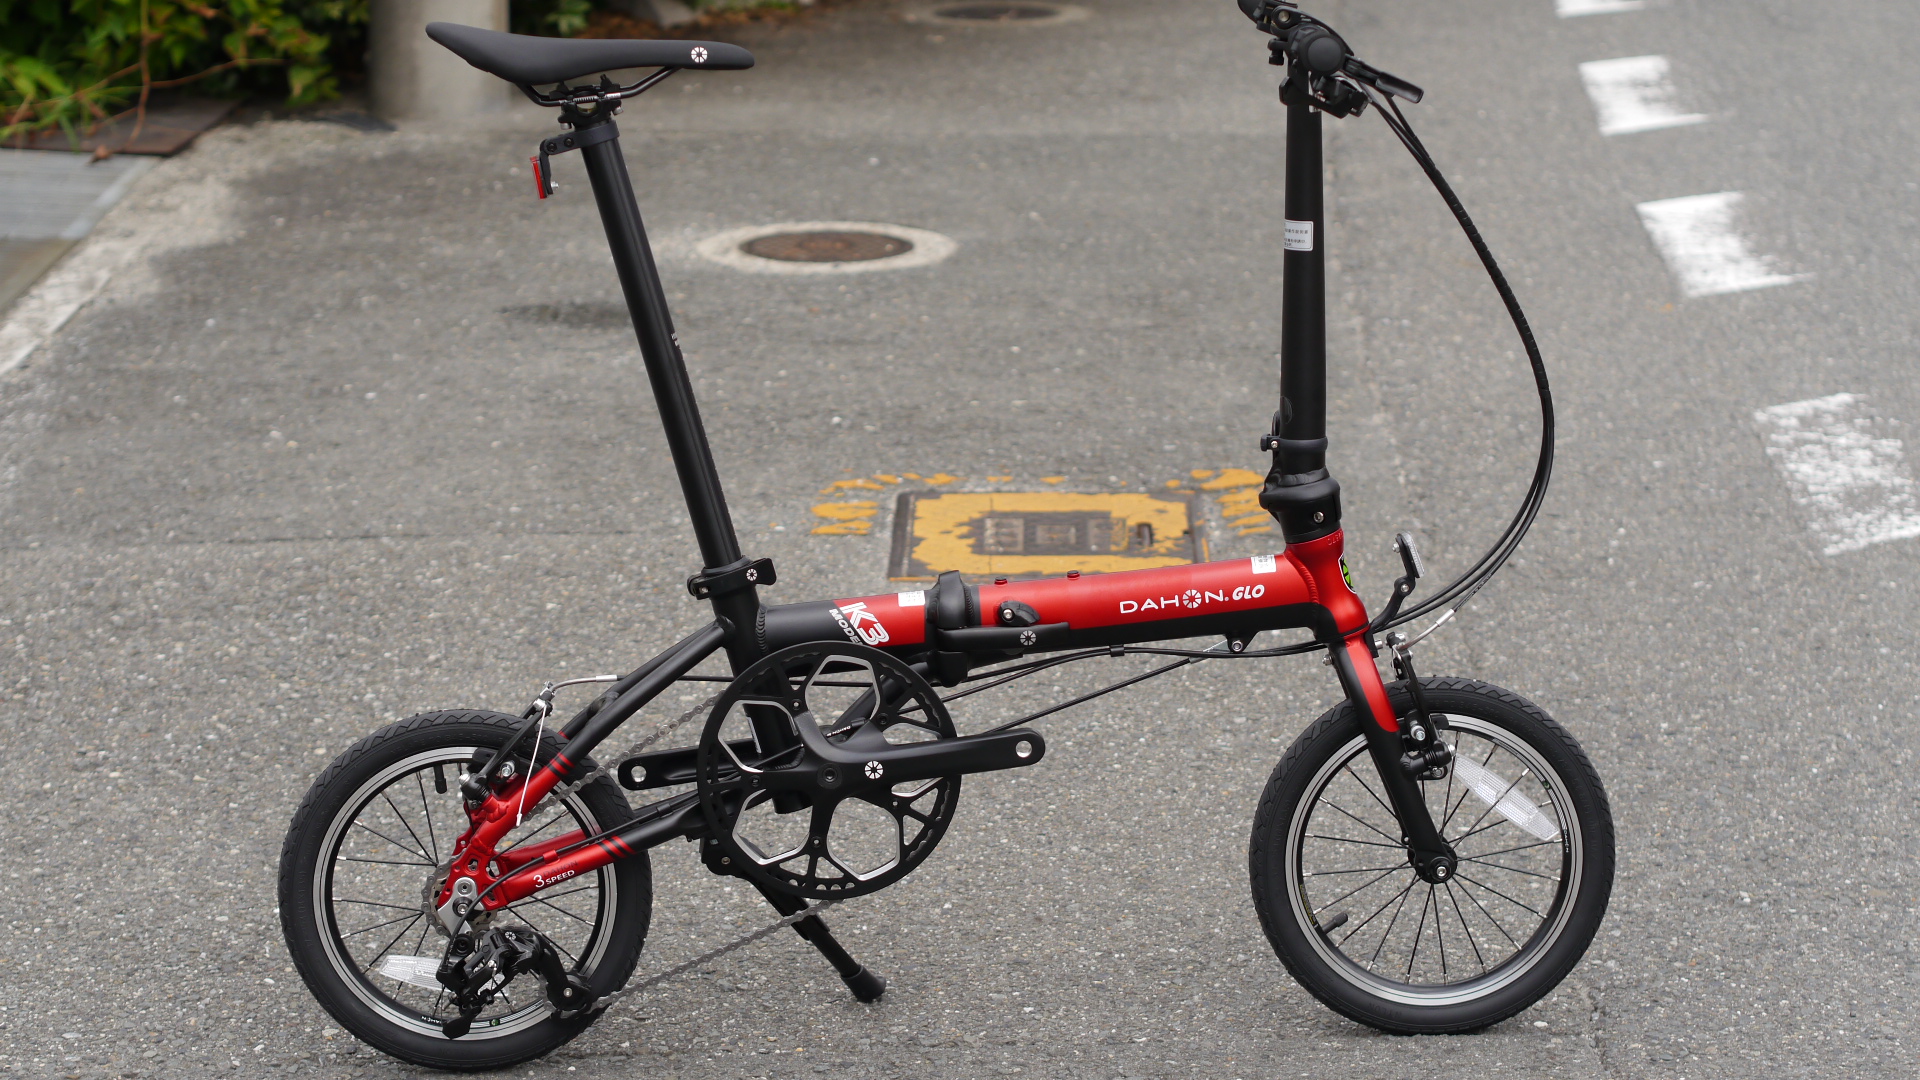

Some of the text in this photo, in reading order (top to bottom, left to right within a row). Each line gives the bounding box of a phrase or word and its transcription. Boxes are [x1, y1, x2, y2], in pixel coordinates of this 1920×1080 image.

[1232, 584, 1265, 601] GLO
[828, 608, 864, 646] MODE
[839, 601, 890, 646] K3
[533, 869, 575, 888] 3 SPEED
[542, 860, 579, 878] DAHON
